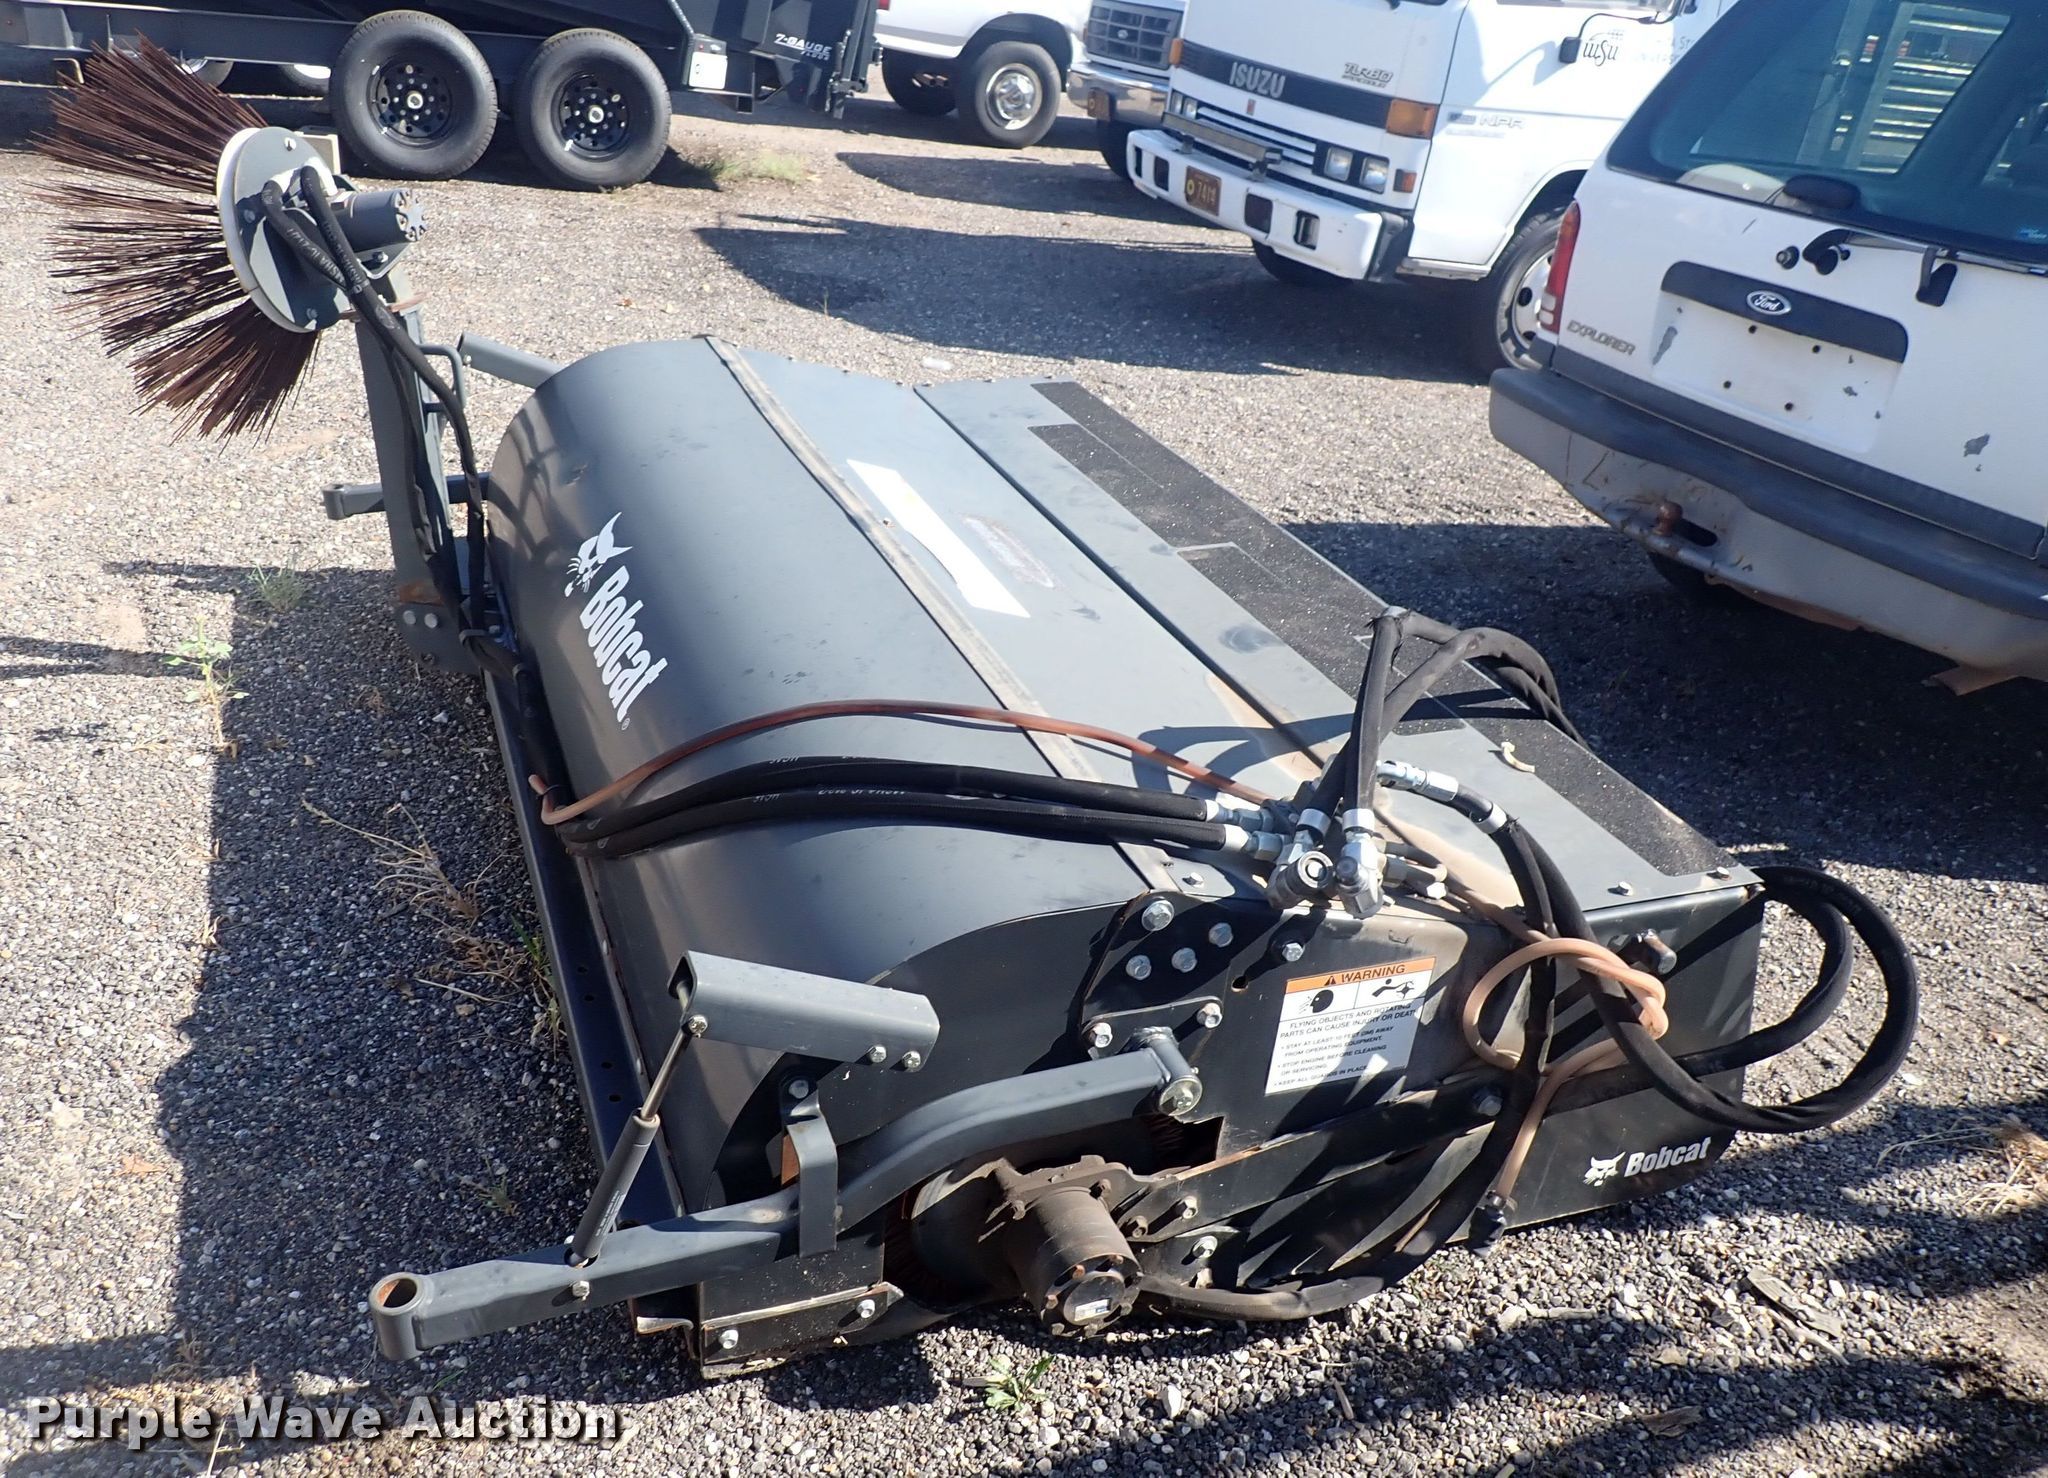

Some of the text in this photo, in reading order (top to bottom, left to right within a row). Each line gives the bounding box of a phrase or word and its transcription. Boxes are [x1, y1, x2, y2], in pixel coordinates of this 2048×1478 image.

[1229, 62, 1286, 98] ISUZU
[1755, 293, 1779, 312] Ford
[1566, 319, 1636, 356] EXPLORER
[580, 565, 668, 722] Bobcat
[1341, 964, 1405, 983] WARNING
[1279, 1029, 1304, 1038] PARTS
[1306, 1025, 1322, 1033] CAN
[1324, 1021, 1349, 1030] CAUSE
[1352, 1015, 1380, 1026] INJURY
[1380, 1013, 1392, 1021] OR
[1289, 1002, 1411, 1029] FLYING OBJECTS AND ROTATING
[1284, 1049, 1303, 1057] FROM
[1304, 1042, 1342, 1053] OPERATING
[1312, 1036, 1332, 1044] LEAST
[1300, 1055, 1324, 1064] ENGINE
[1326, 1050, 1353, 1059] BEFORE
[1353, 1044, 1387, 1055] CLEANING
[1624, 1136, 1711, 1177] Bobcat
